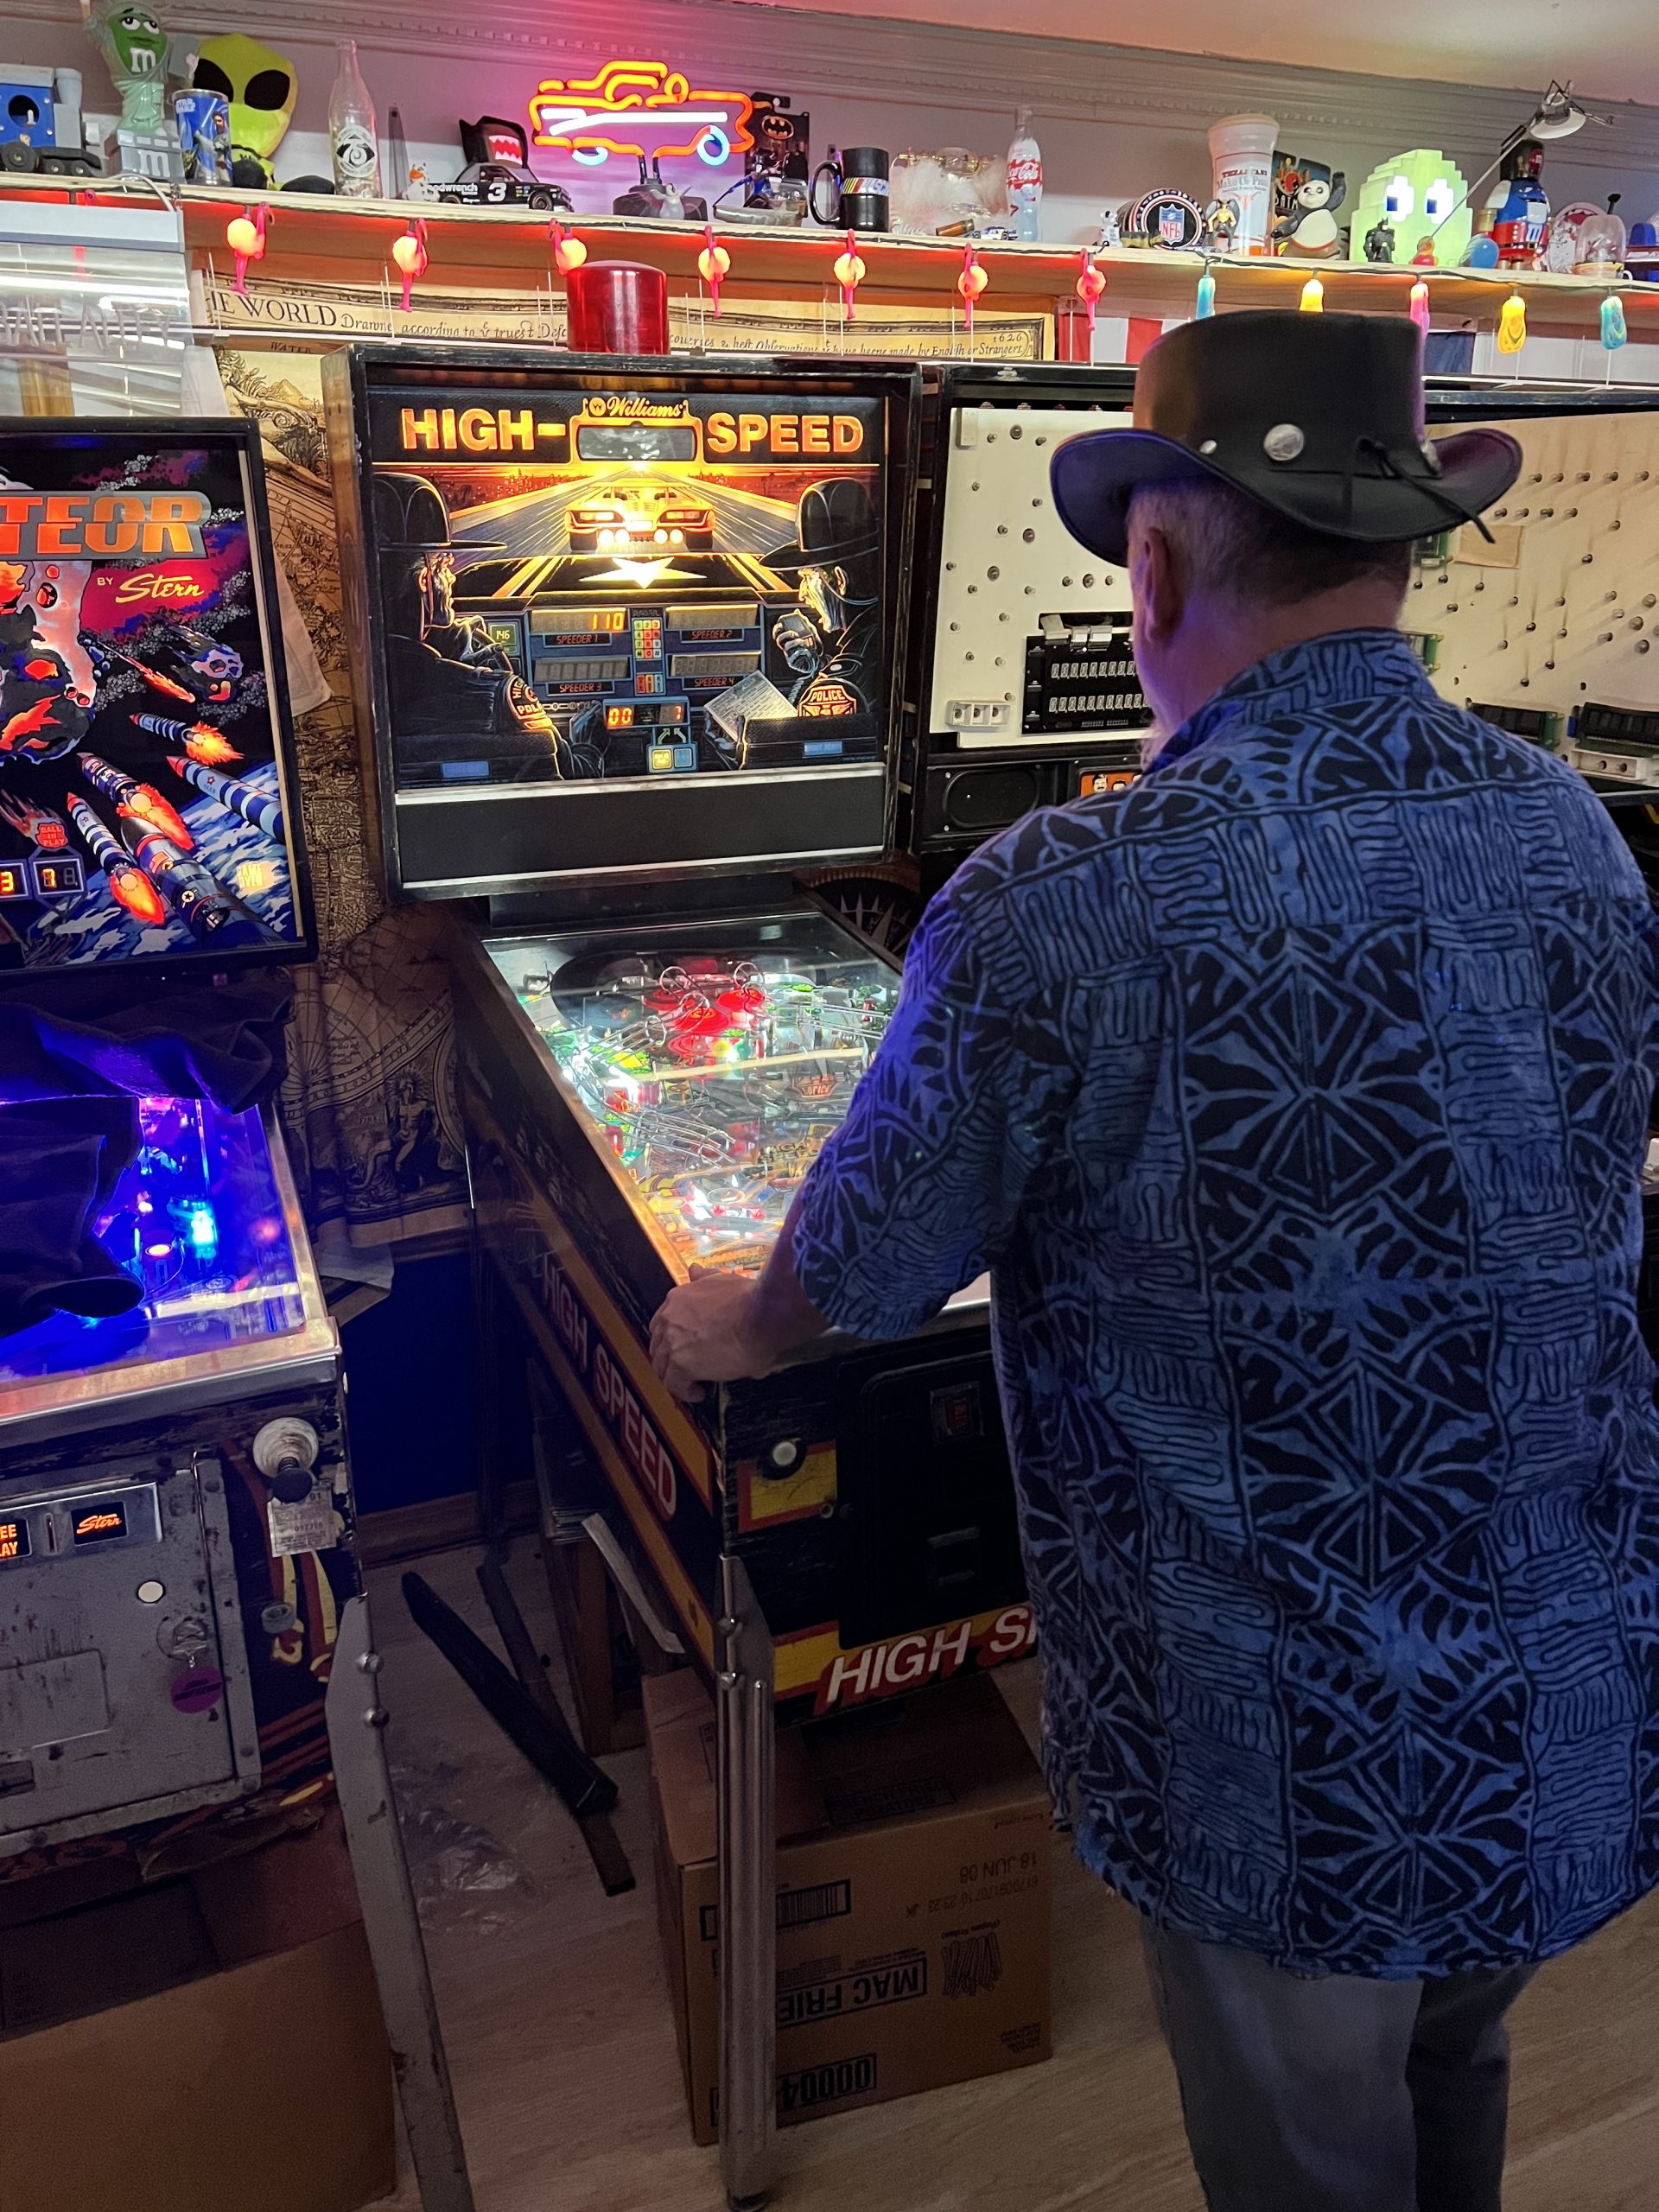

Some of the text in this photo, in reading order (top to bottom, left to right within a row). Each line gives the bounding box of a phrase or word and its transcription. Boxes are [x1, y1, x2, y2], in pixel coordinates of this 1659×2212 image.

[487, 183, 506, 201] 3
[1162, 222, 1180, 238] NFL
[238, 295, 337, 327] WORLD
[993, 332, 1023, 344] 1626
[607, 396, 683, 416] Williams
[706, 412, 864, 454] SPEED
[97, 573, 205, 603] BY Stern
[496, 629, 510, 640] 146
[556, 634, 592, 645] SPEEDER
[691, 629, 733, 639] SPEEDER 2
[559, 683, 594, 693] SPEEDER
[694, 677, 728, 687] SPEEDER
[809, 690, 846, 702] POLICE
[608, 707, 632, 725] 00
[543, 1252, 677, 1516] HIGH SPEED
[76, 1513, 122, 1535] Stern
[826, 1621, 972, 1703] HIGH
[959, 1864, 978, 1884] 08
[982, 1856, 1016, 1879] JUN
[854, 1965, 919, 2005] MAC
[781, 2056, 872, 2109] 00004
